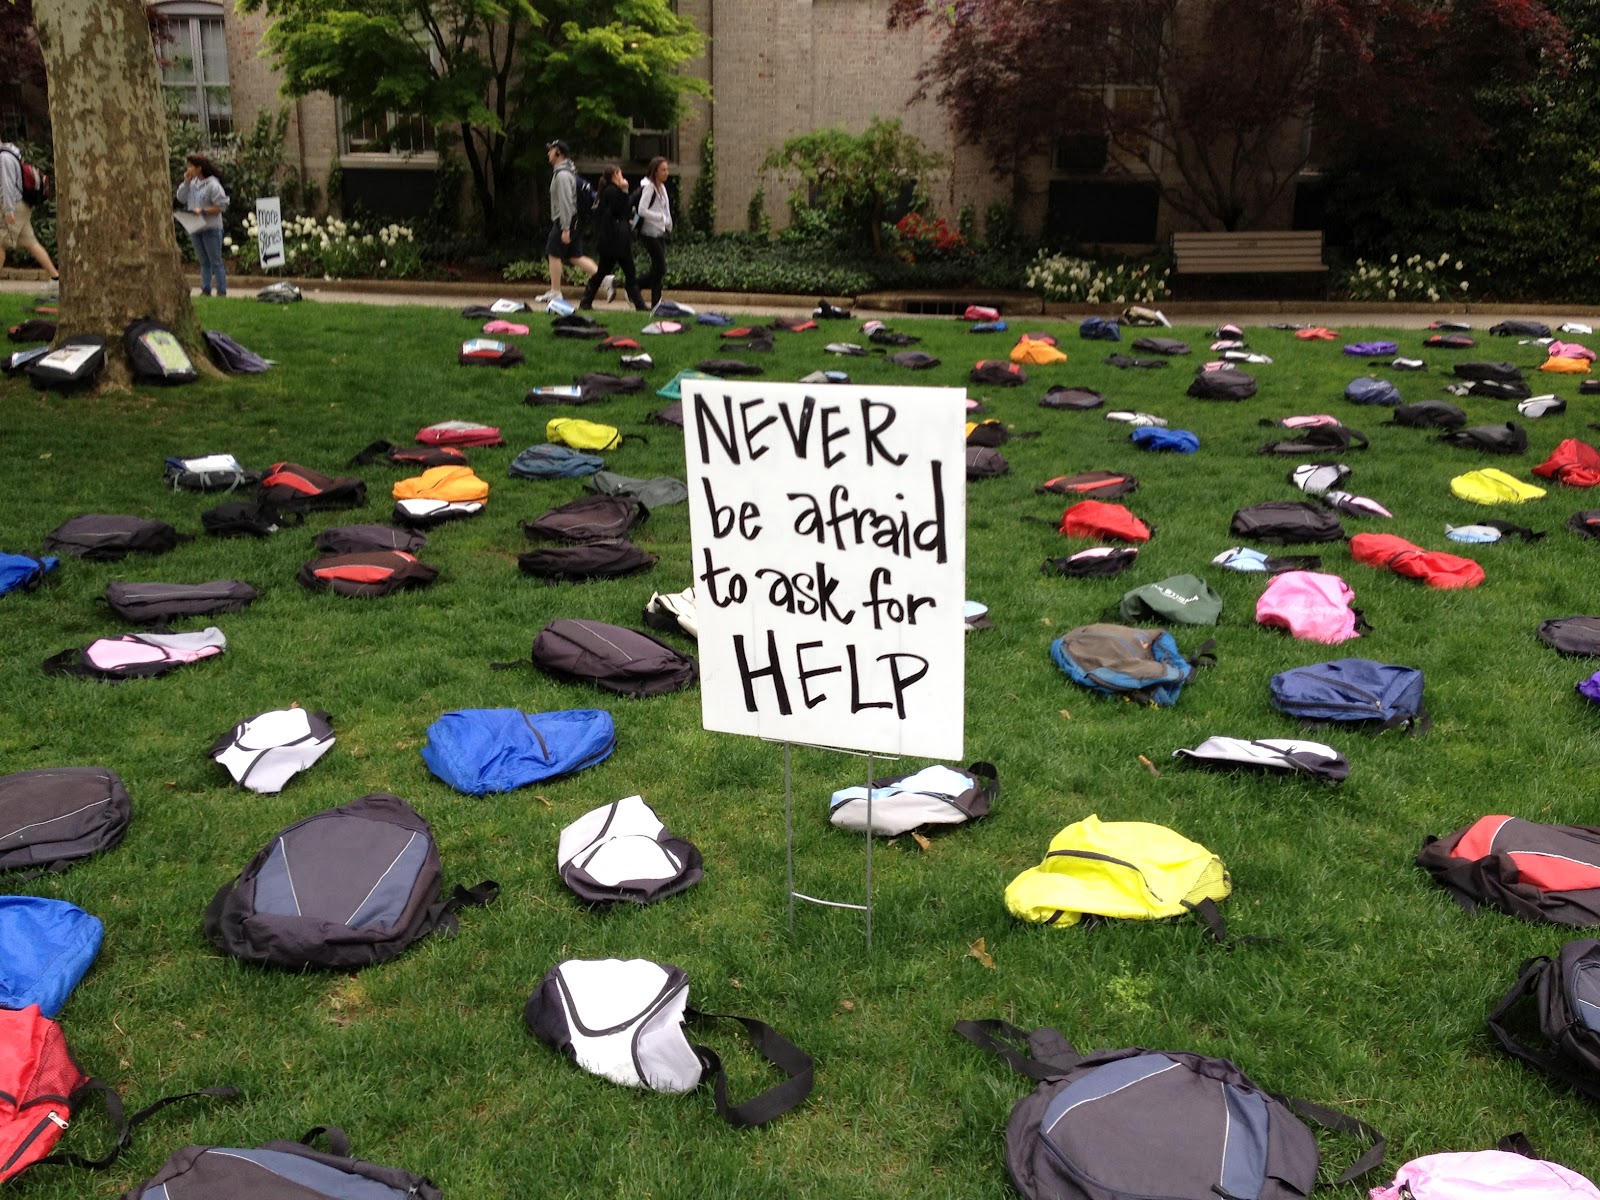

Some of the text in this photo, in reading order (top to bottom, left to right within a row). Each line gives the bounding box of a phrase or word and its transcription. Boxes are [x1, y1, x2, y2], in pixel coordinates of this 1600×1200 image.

[258, 208, 279, 228] more
[693, 393, 909, 468] NEVER
[701, 460, 948, 564] be afraid
[700, 547, 936, 630] to ask for
[732, 629, 930, 720] HELP
